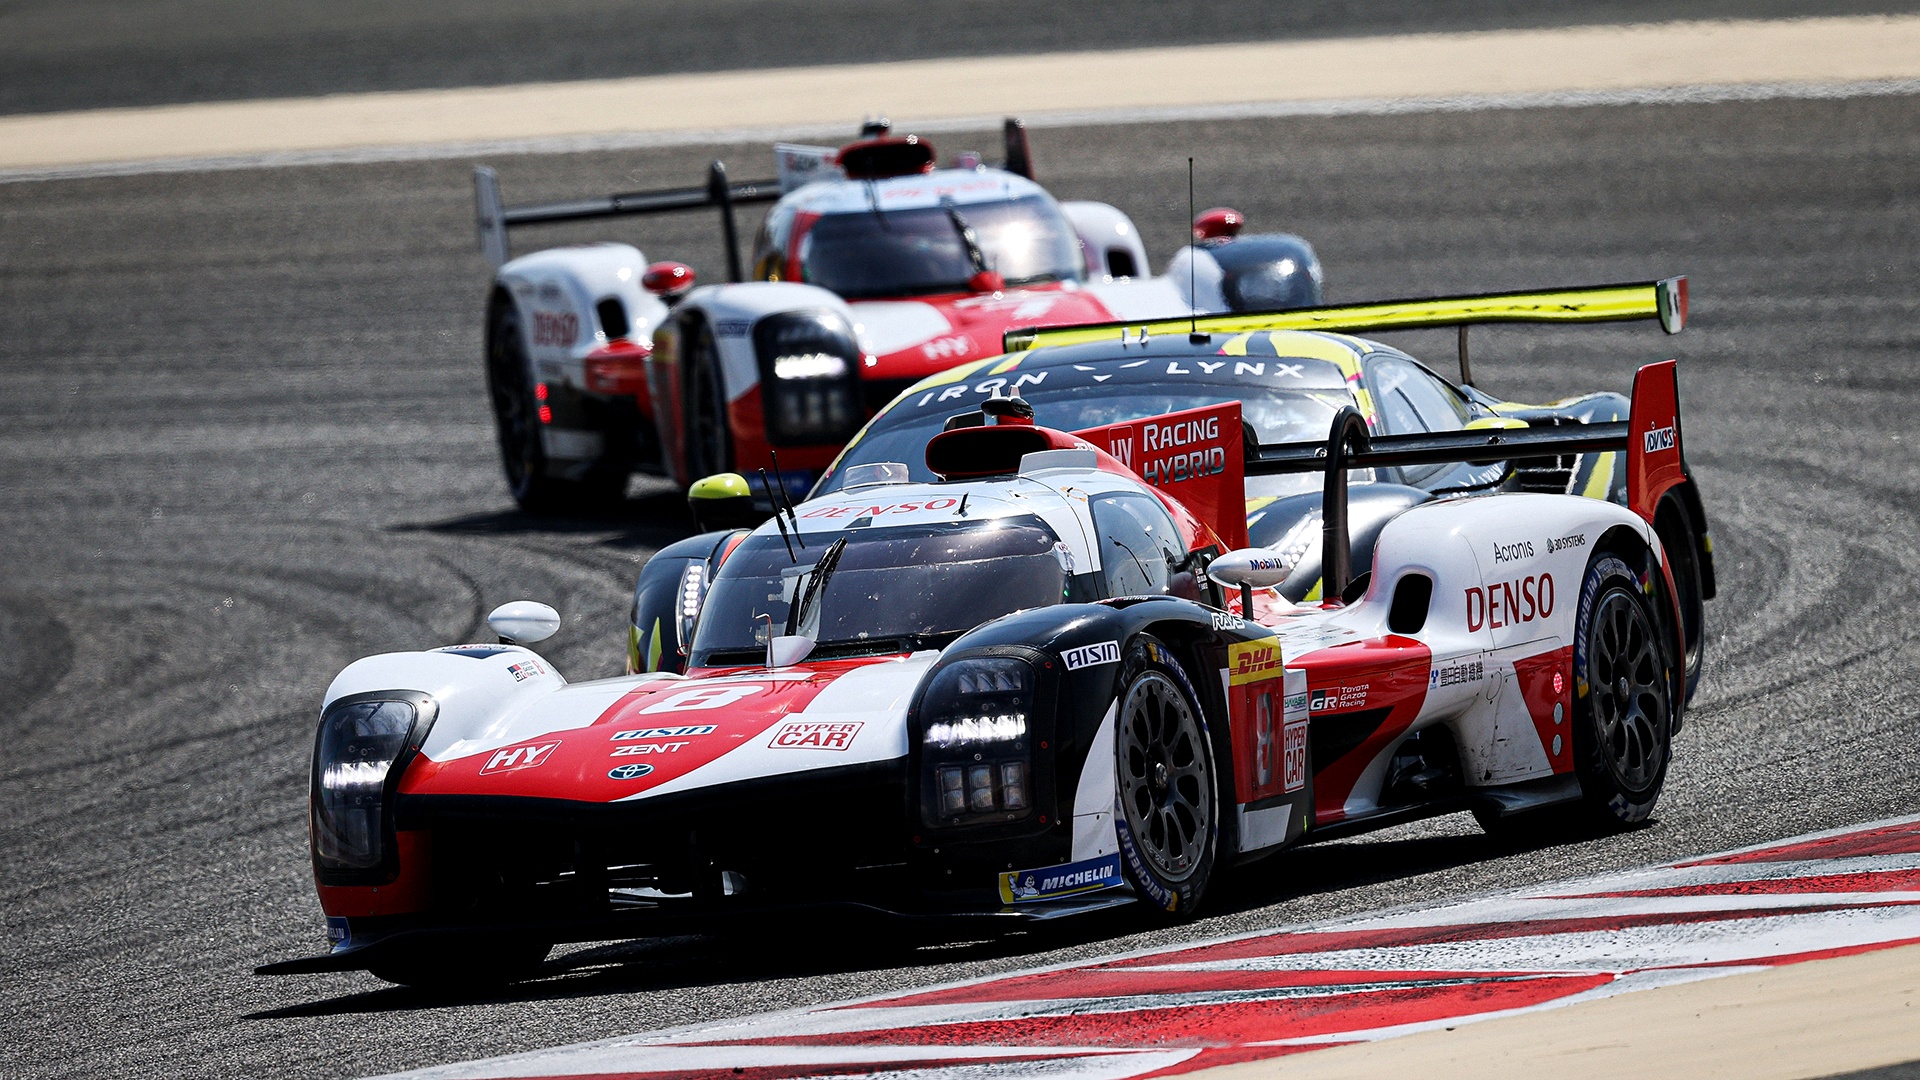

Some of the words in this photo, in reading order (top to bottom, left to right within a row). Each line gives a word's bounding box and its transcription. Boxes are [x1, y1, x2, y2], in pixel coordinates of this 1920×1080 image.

[917, 371, 1049, 408] IRON
[1167, 361, 1303, 377] LYNX
[1143, 446, 1226, 487] HYBRID
[800, 498, 957, 519] DENSO
[1493, 540, 1535, 564] Acronis
[1553, 538, 1562, 551] 3D
[1562, 534, 1585, 549] SYSTEMS
[1250, 559, 1275, 571] Mobil
[1464, 572, 1554, 633] DENSO
[1210, 612, 1246, 632] RAYS
[1578, 575, 1599, 656] MICHELIN
[1067, 642, 1118, 667] AISIN
[1238, 646, 1276, 675] DHL
[639, 684, 764, 715] 8
[1310, 696, 1338, 711] GR
[1339, 699, 1366, 708] Racing
[611, 725, 715, 740] AISIN
[777, 731, 850, 748] CAR
[783, 723, 856, 735] HYPER
[1285, 725, 1306, 749] HYPER
[485, 743, 552, 770] HY
[609, 742, 690, 757] ZENT
[1285, 748, 1305, 785] CAR
[1119, 827, 1164, 902] MICHELIN
[1041, 864, 1114, 890] MICHELIN
